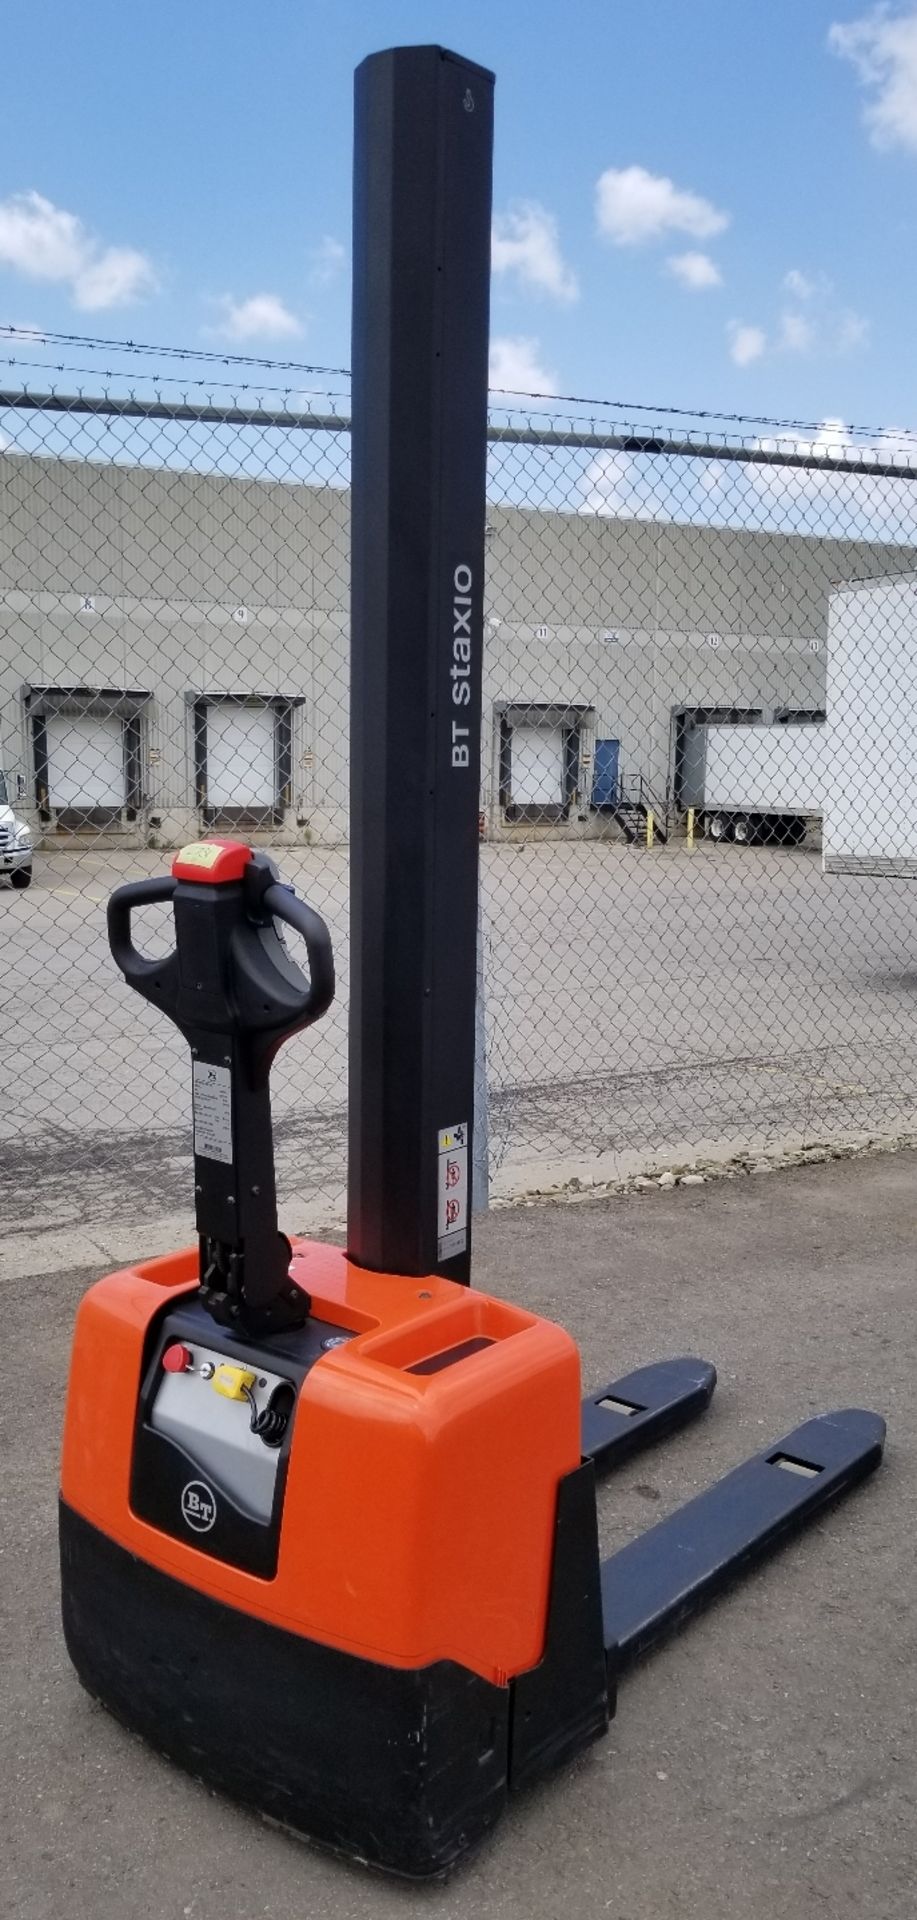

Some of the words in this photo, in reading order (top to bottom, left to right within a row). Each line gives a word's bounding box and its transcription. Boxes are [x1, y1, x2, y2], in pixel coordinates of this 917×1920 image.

[237, 609, 244, 619] 9
[539, 628, 547, 637] 11
[710, 637, 718, 646] 12
[451, 720, 470, 768] BT
[187, 1490, 213, 1522] BT
